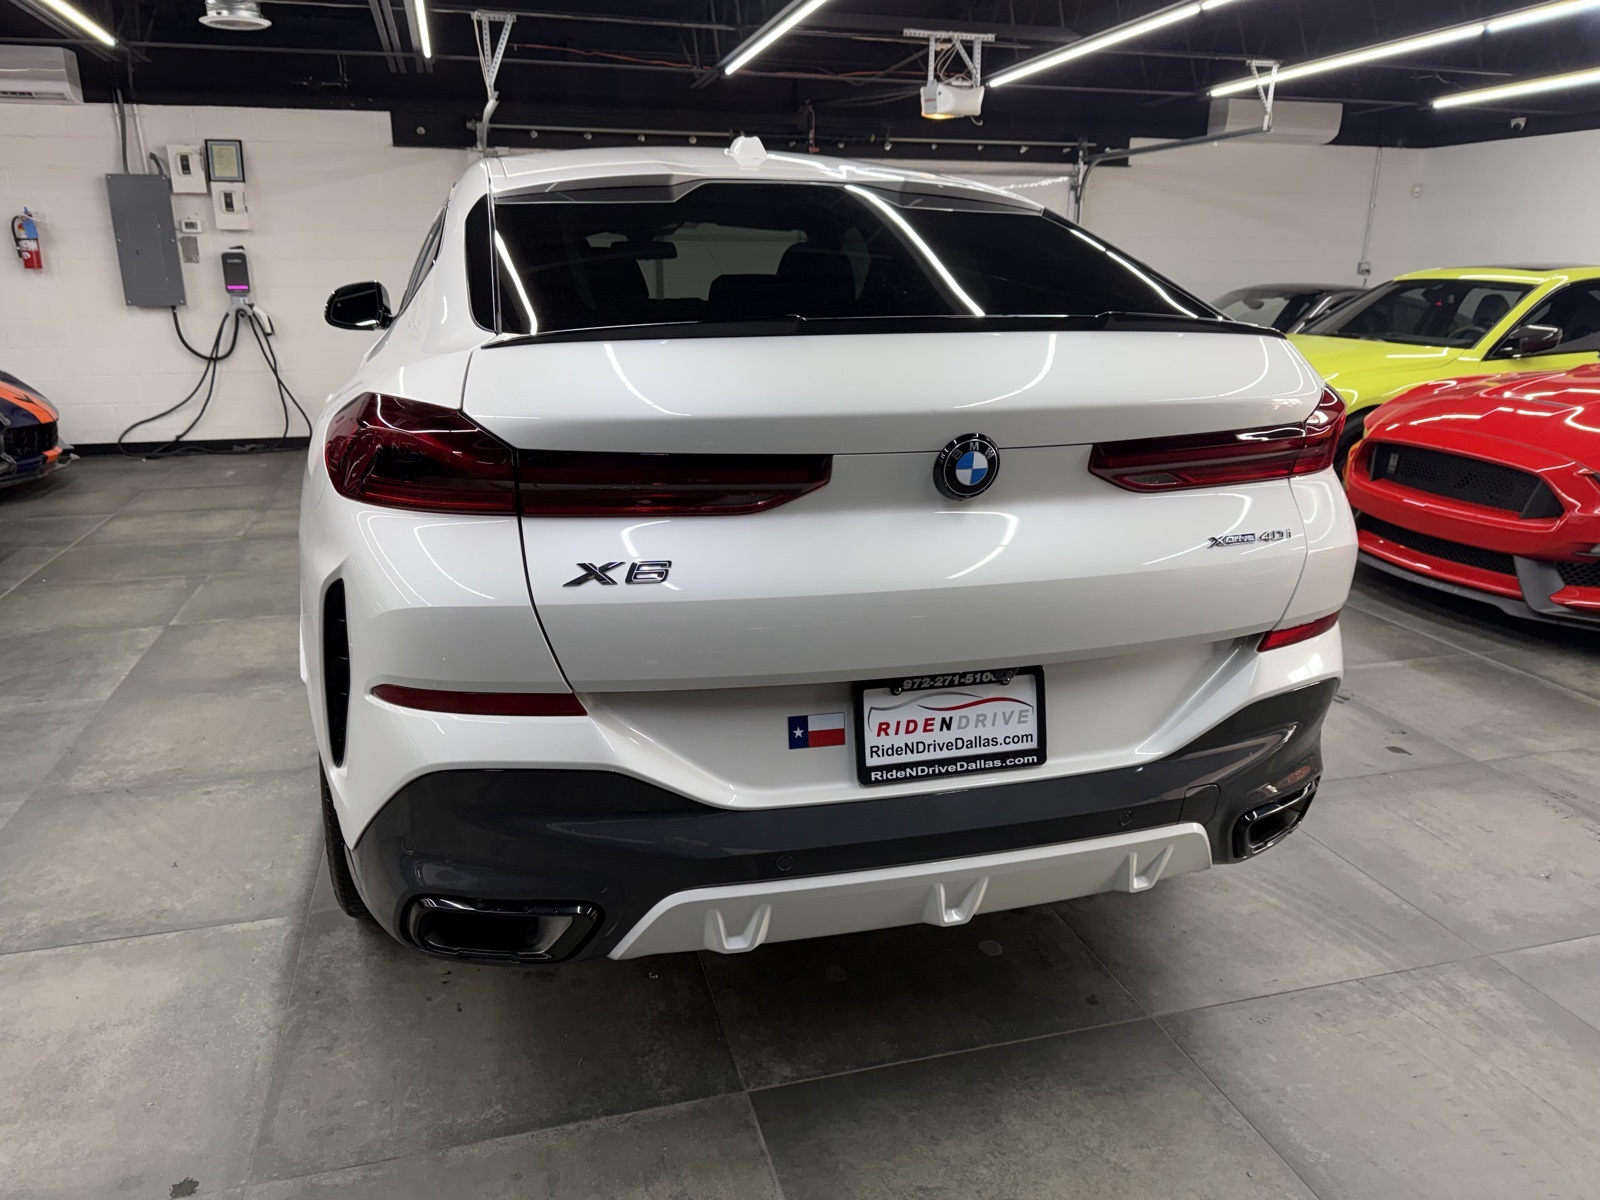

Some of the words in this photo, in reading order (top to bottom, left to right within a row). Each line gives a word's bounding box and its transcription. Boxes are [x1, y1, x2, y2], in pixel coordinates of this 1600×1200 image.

[952, 442, 995, 460] BMW
[1257, 528, 1292, 542] 40i
[562, 560, 673, 587] X6
[870, 733, 1034, 758] RideNDriveDallas.com
[871, 755, 1038, 781] RideNDriveDallas.com
